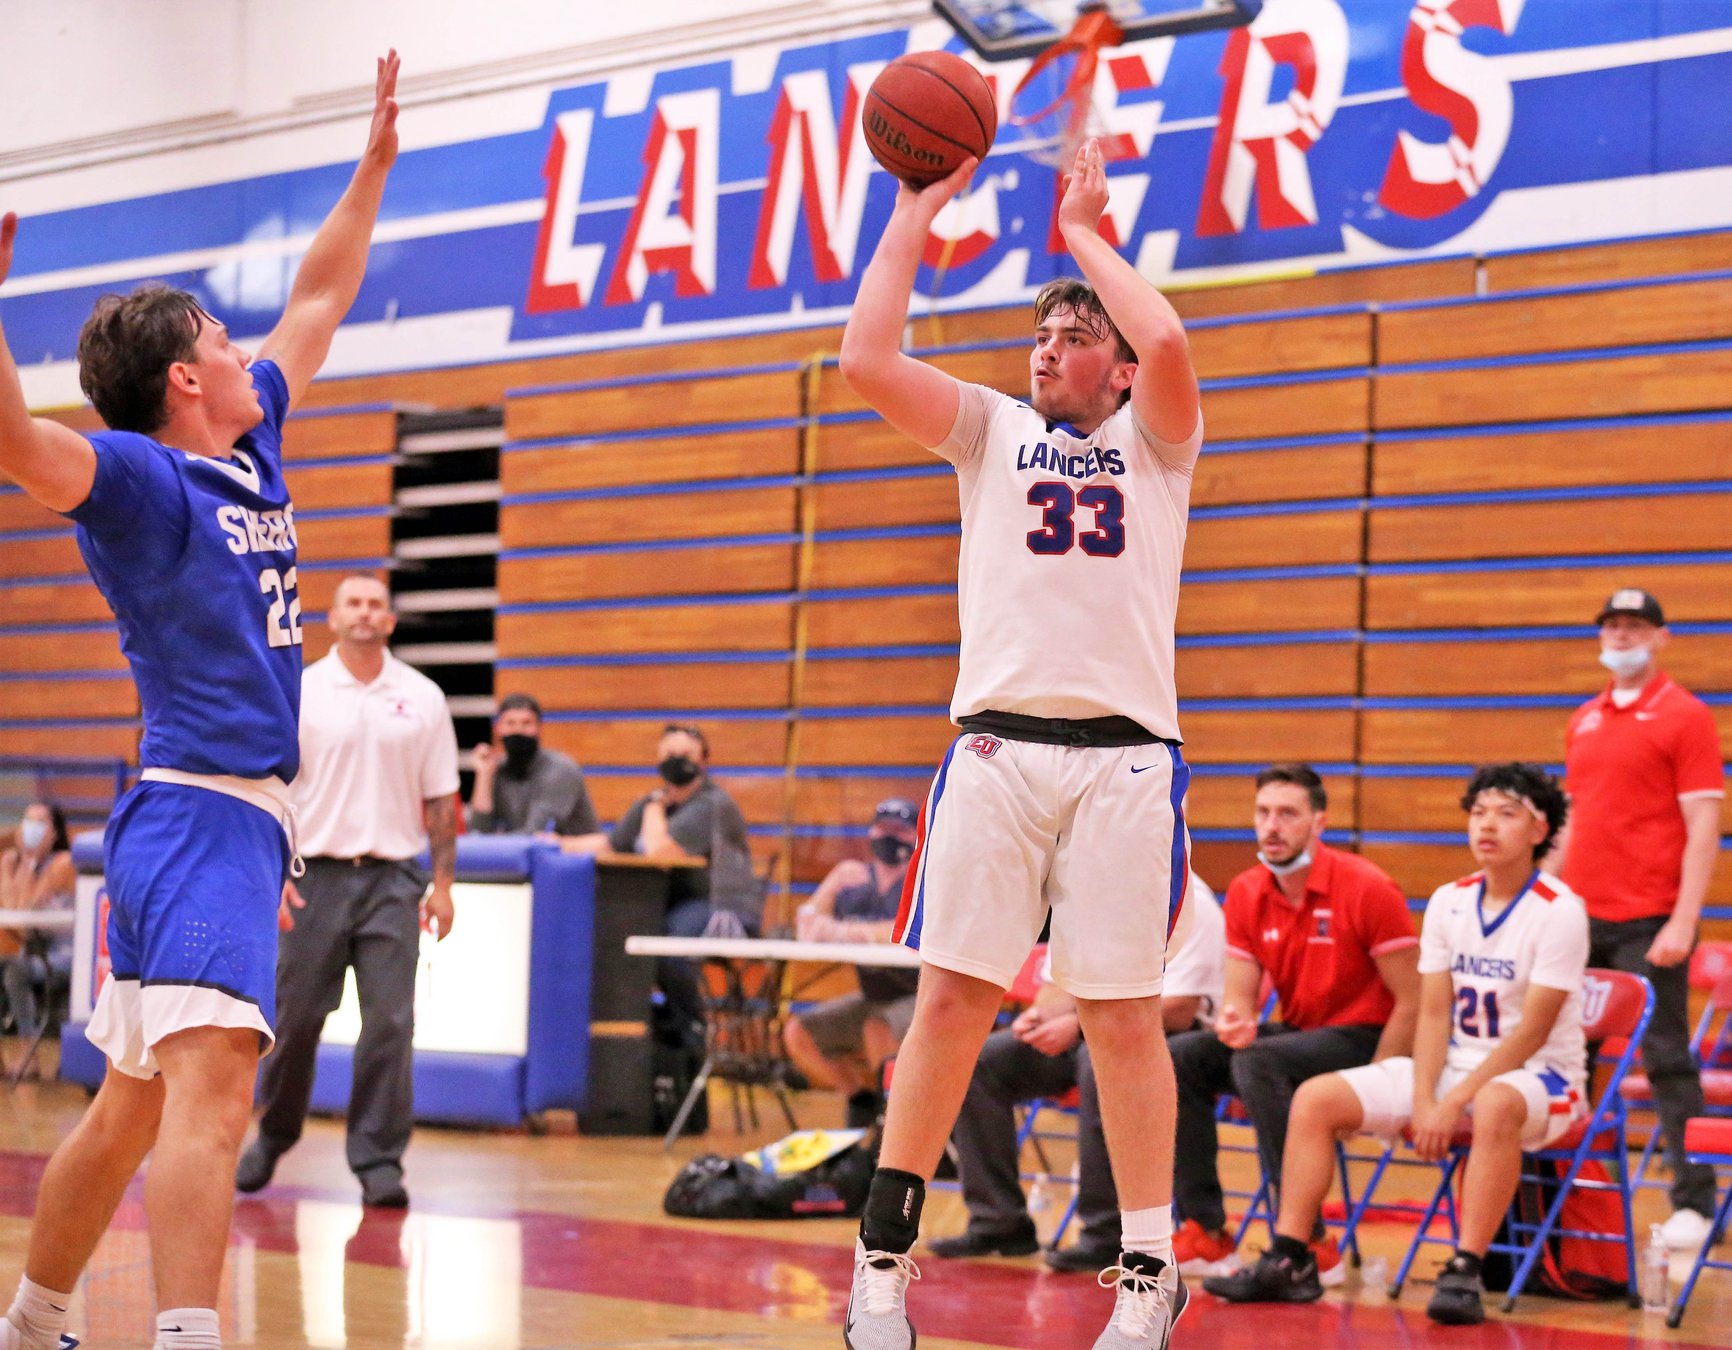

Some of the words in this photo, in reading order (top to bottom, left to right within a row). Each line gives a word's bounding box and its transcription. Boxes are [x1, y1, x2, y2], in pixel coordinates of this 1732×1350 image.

[868, 110, 945, 166] Wilson
[1017, 442, 1126, 479] LANCERS
[1026, 481, 1126, 558] 33
[259, 566, 303, 648] 22
[1456, 986, 1500, 1038] 21
